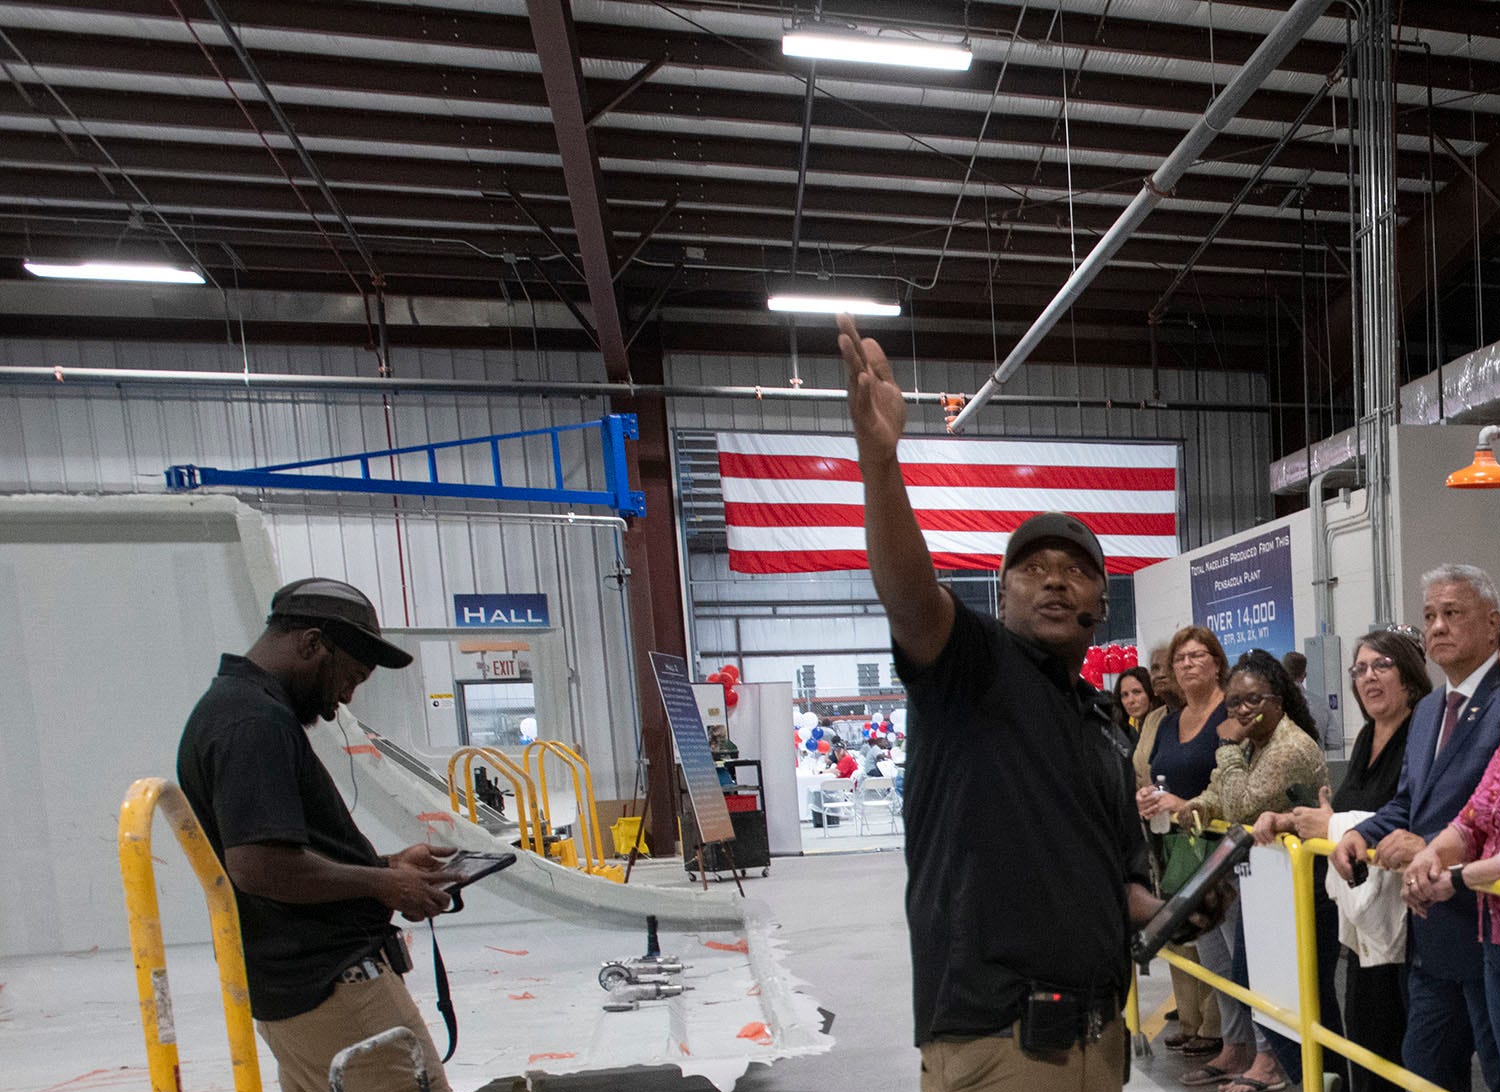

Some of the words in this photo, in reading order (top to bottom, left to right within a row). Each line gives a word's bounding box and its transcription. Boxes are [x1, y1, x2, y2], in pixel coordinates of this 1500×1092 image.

[463, 607, 543, 623] HALL
[1207, 611, 1233, 632] OVER
[1237, 600, 1276, 628] 14,000
[492, 660, 515, 676] EXIT
